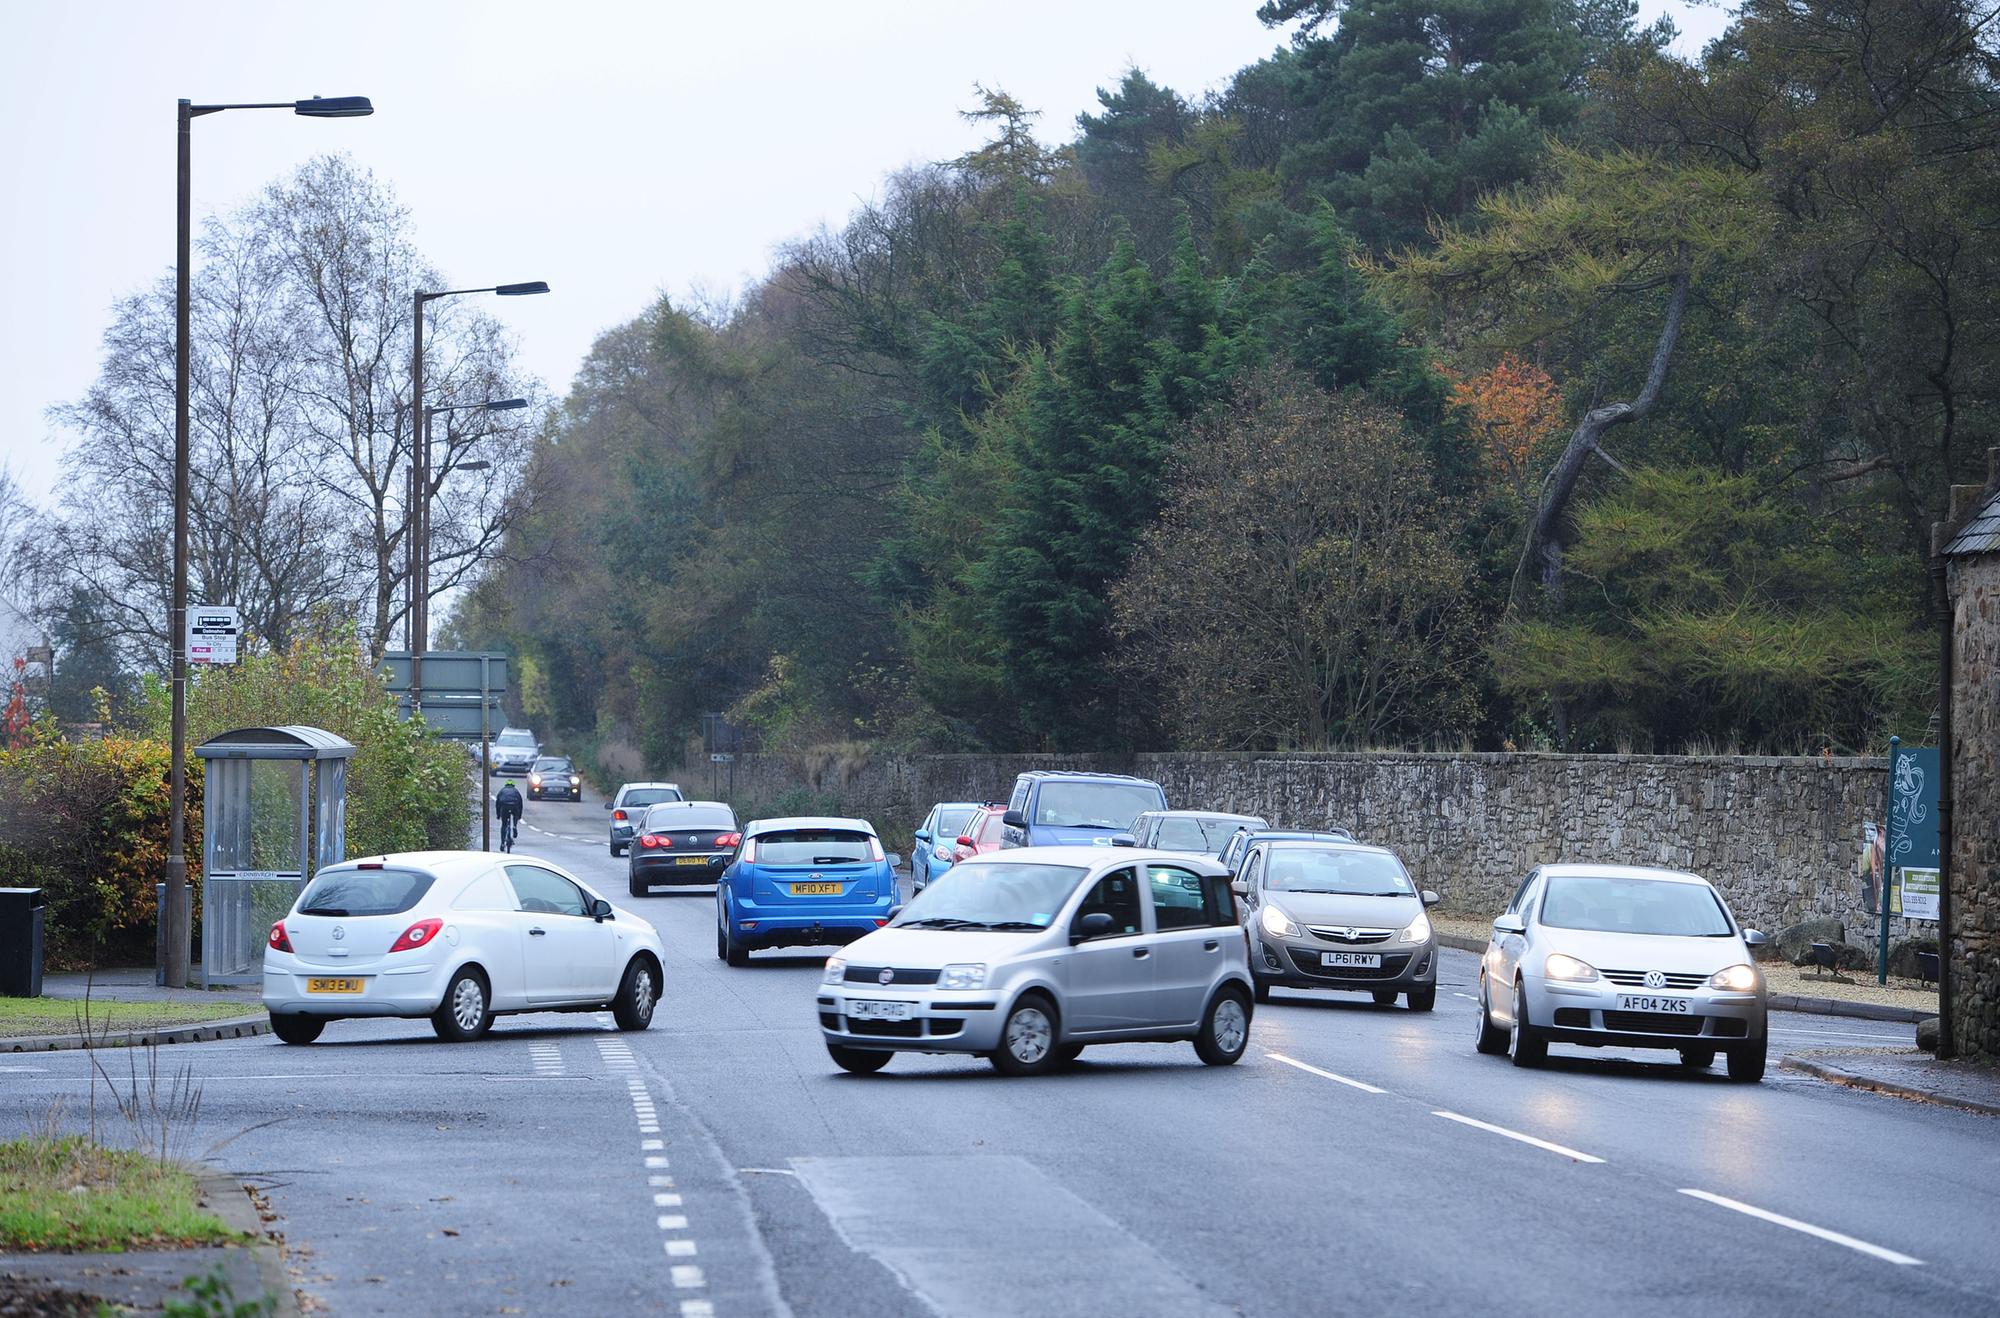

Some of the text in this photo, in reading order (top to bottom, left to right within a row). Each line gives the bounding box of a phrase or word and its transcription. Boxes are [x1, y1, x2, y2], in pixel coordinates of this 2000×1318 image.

[795, 882, 837, 894] MF10 XFT
[1328, 953, 1375, 965] LP61 RWY
[312, 979, 358, 991] SM13 EWU
[1623, 996, 1687, 1012] AF04 ZKS
